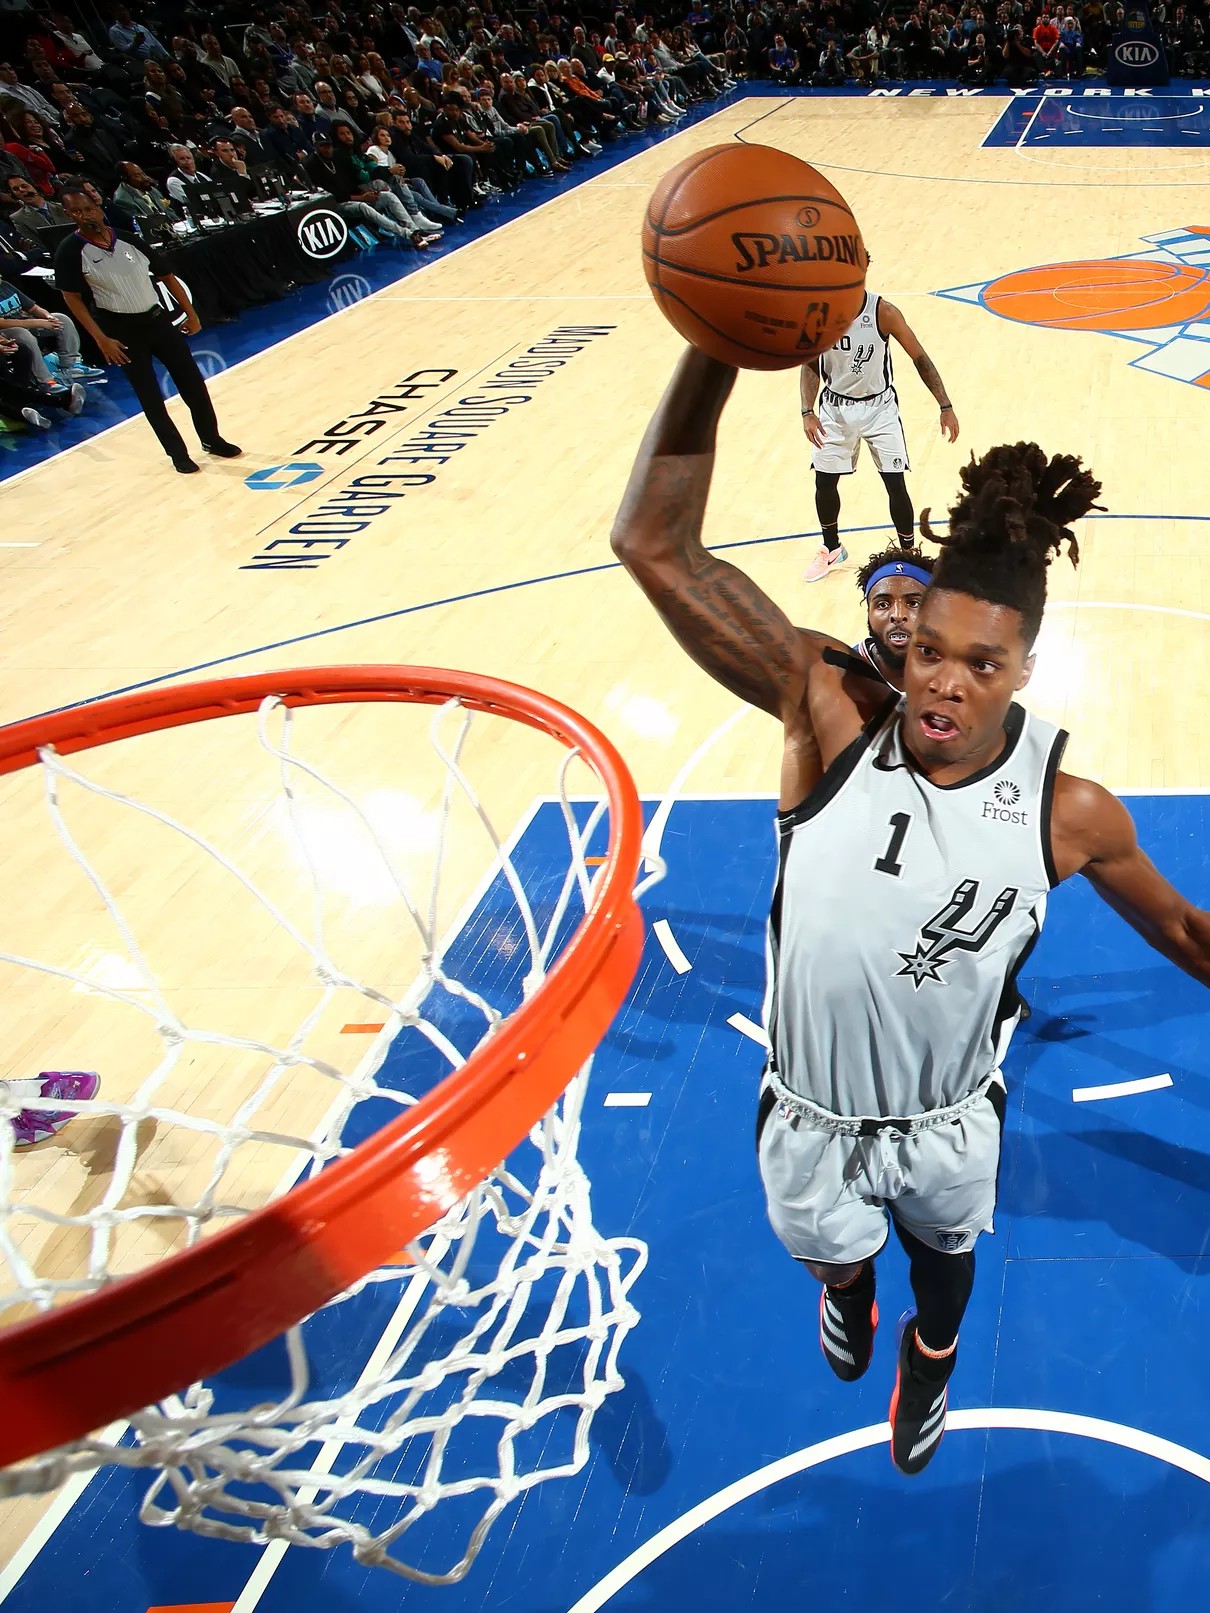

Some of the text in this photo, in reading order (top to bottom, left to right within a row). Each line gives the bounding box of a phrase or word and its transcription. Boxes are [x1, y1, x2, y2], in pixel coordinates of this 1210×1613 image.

[1122, 46, 1152, 61] KIA
[868, 88, 984, 97] NEW
[1010, 88, 1154, 97] YORK
[303, 218, 343, 252] KIA
[292, 368, 458, 455] CHASE
[238, 325, 618, 569] MADISON SQUARE GARDEN
[981, 801, 1028, 826] Frost
[874, 812, 913, 877] 1
